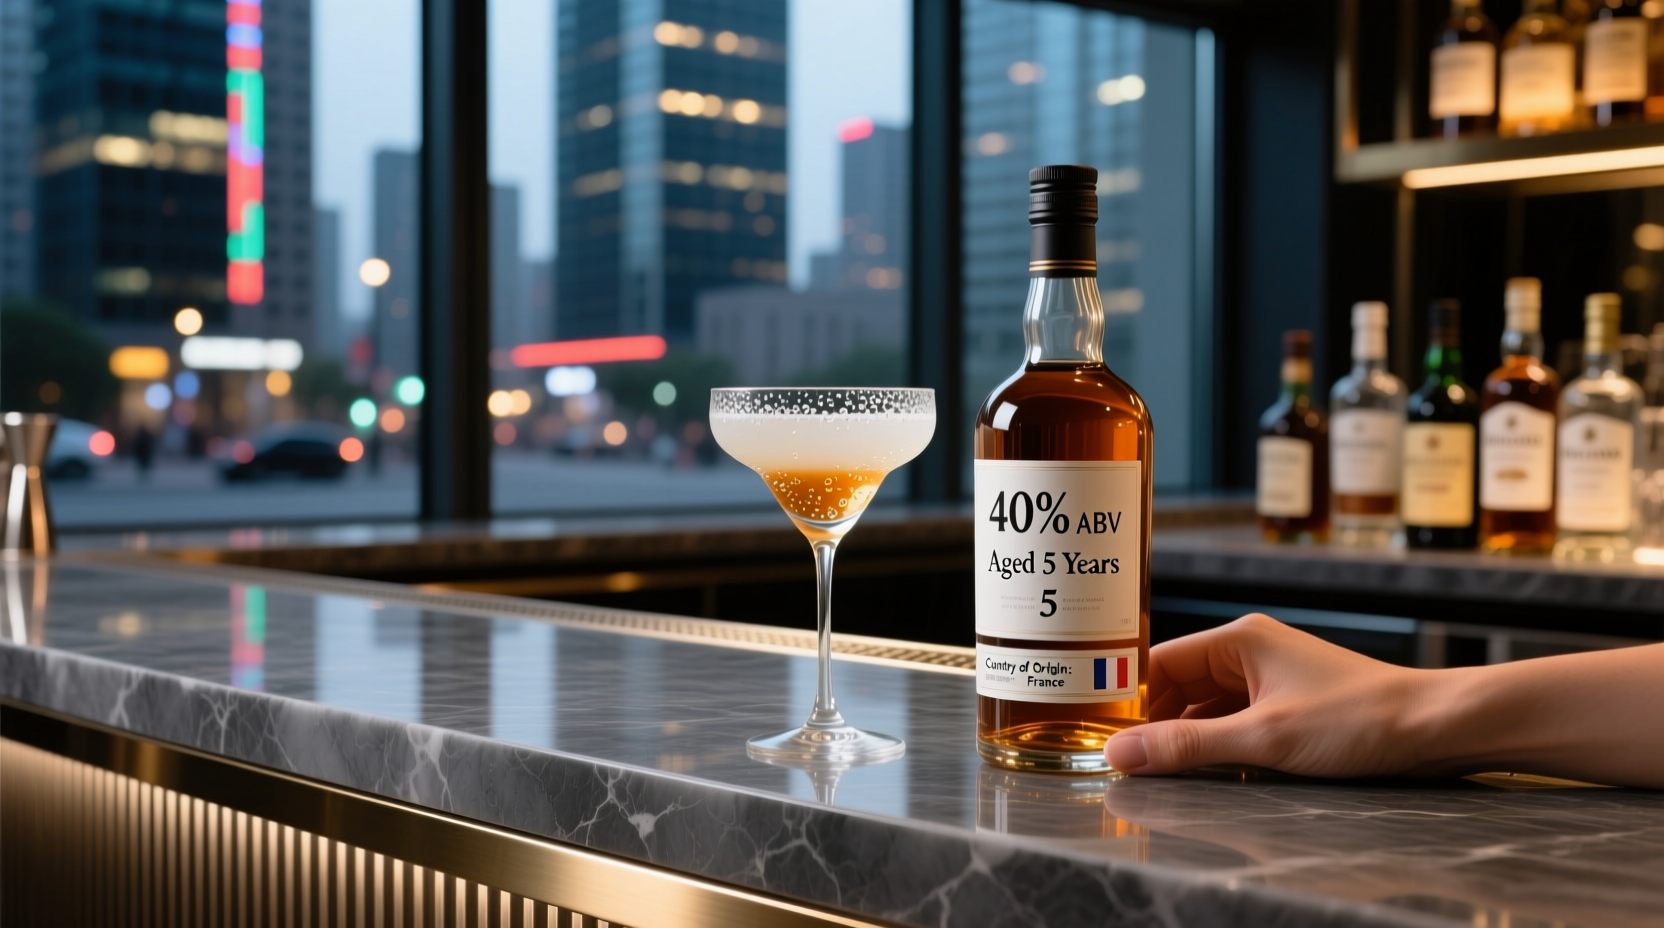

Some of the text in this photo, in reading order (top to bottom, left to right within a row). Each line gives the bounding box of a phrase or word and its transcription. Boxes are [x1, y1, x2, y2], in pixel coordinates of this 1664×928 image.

[989, 490, 1122, 534] 40% ABV
[988, 549, 1120, 580] Aged 5 Years
[1039, 589, 1058, 618] 5
[1019, 660, 1030, 673] of
[1027, 675, 1065, 687] France
